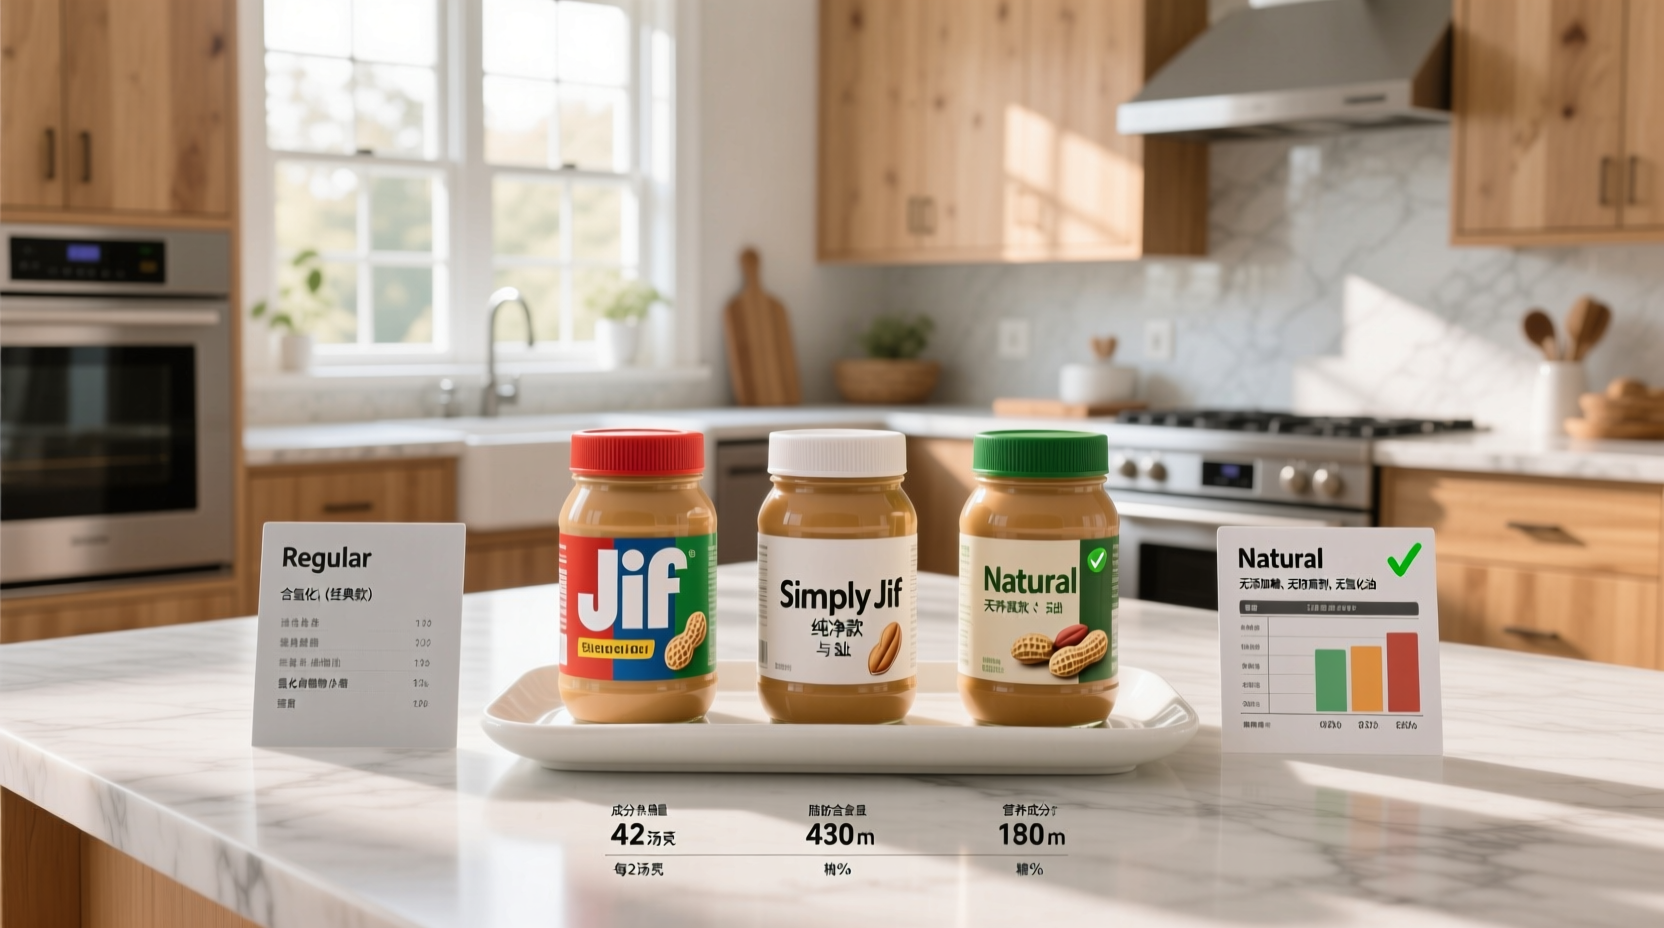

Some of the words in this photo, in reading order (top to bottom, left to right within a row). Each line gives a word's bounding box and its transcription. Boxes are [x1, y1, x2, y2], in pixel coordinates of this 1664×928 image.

[282, 546, 372, 573] Regular
[1238, 547, 1323, 569] Natural
[578, 547, 687, 632] Jif
[984, 565, 1077, 594] Natural
[780, 579, 871, 616] Simply
[874, 576, 903, 609] Jif
[811, 618, 864, 638] 纯净款
